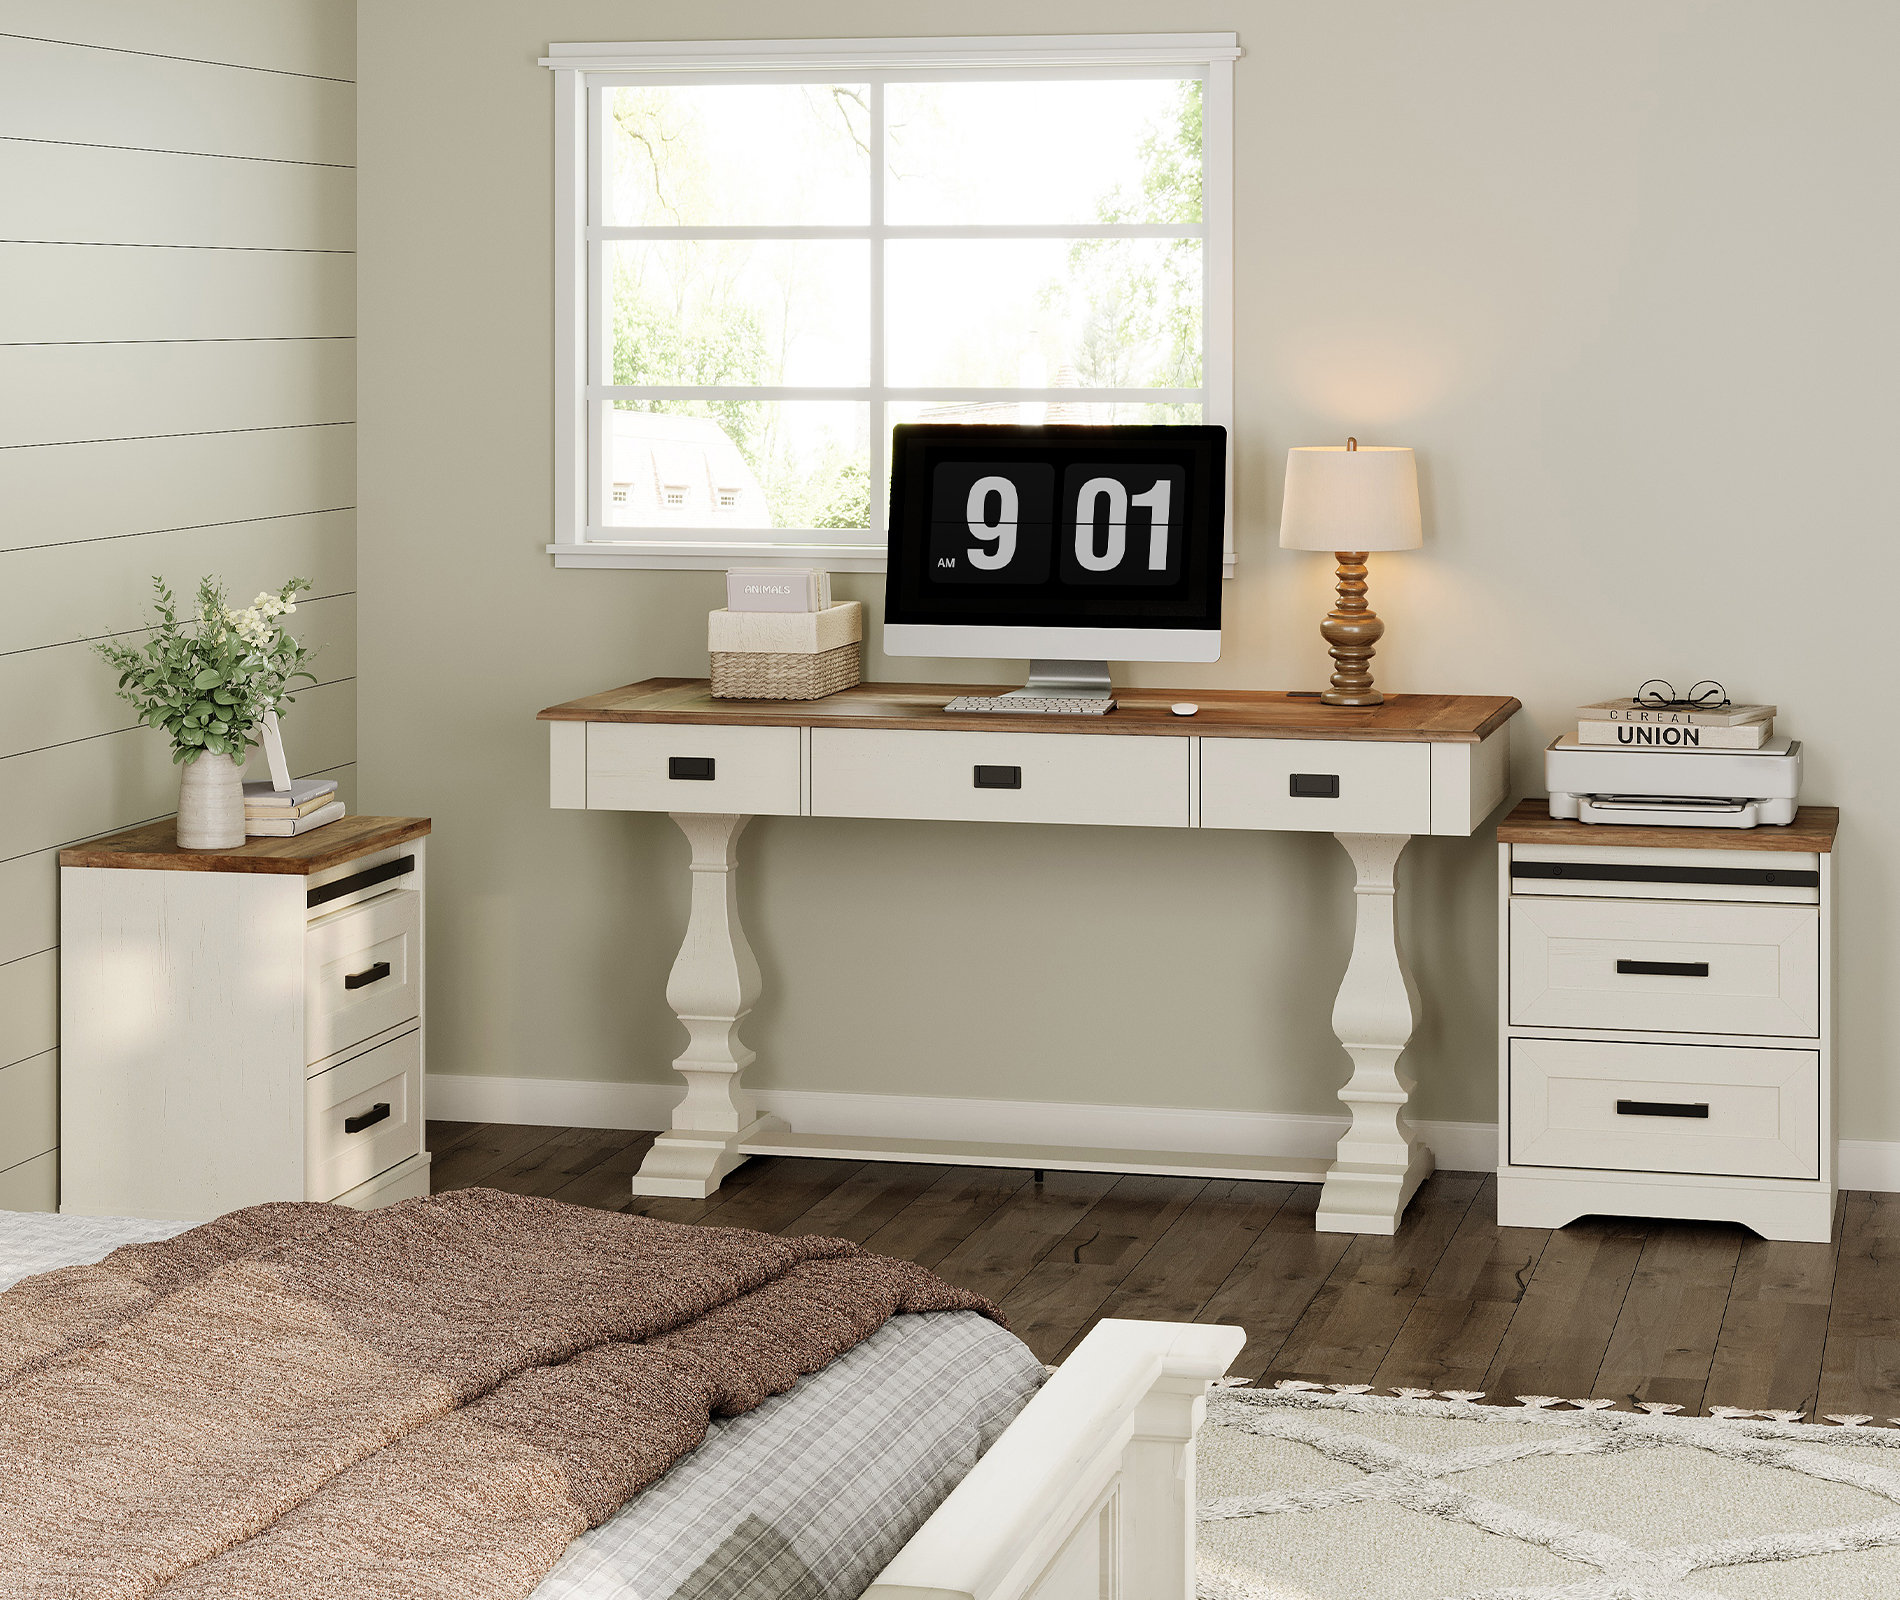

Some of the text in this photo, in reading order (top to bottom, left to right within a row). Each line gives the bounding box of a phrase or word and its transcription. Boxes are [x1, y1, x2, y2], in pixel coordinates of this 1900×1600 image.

[966, 476, 1171, 571] 9 01
[937, 557, 956, 568] AM
[744, 584, 791, 595] ANIMALS
[1609, 709, 1695, 725] CEREAL
[1617, 725, 1700, 746] UNION
